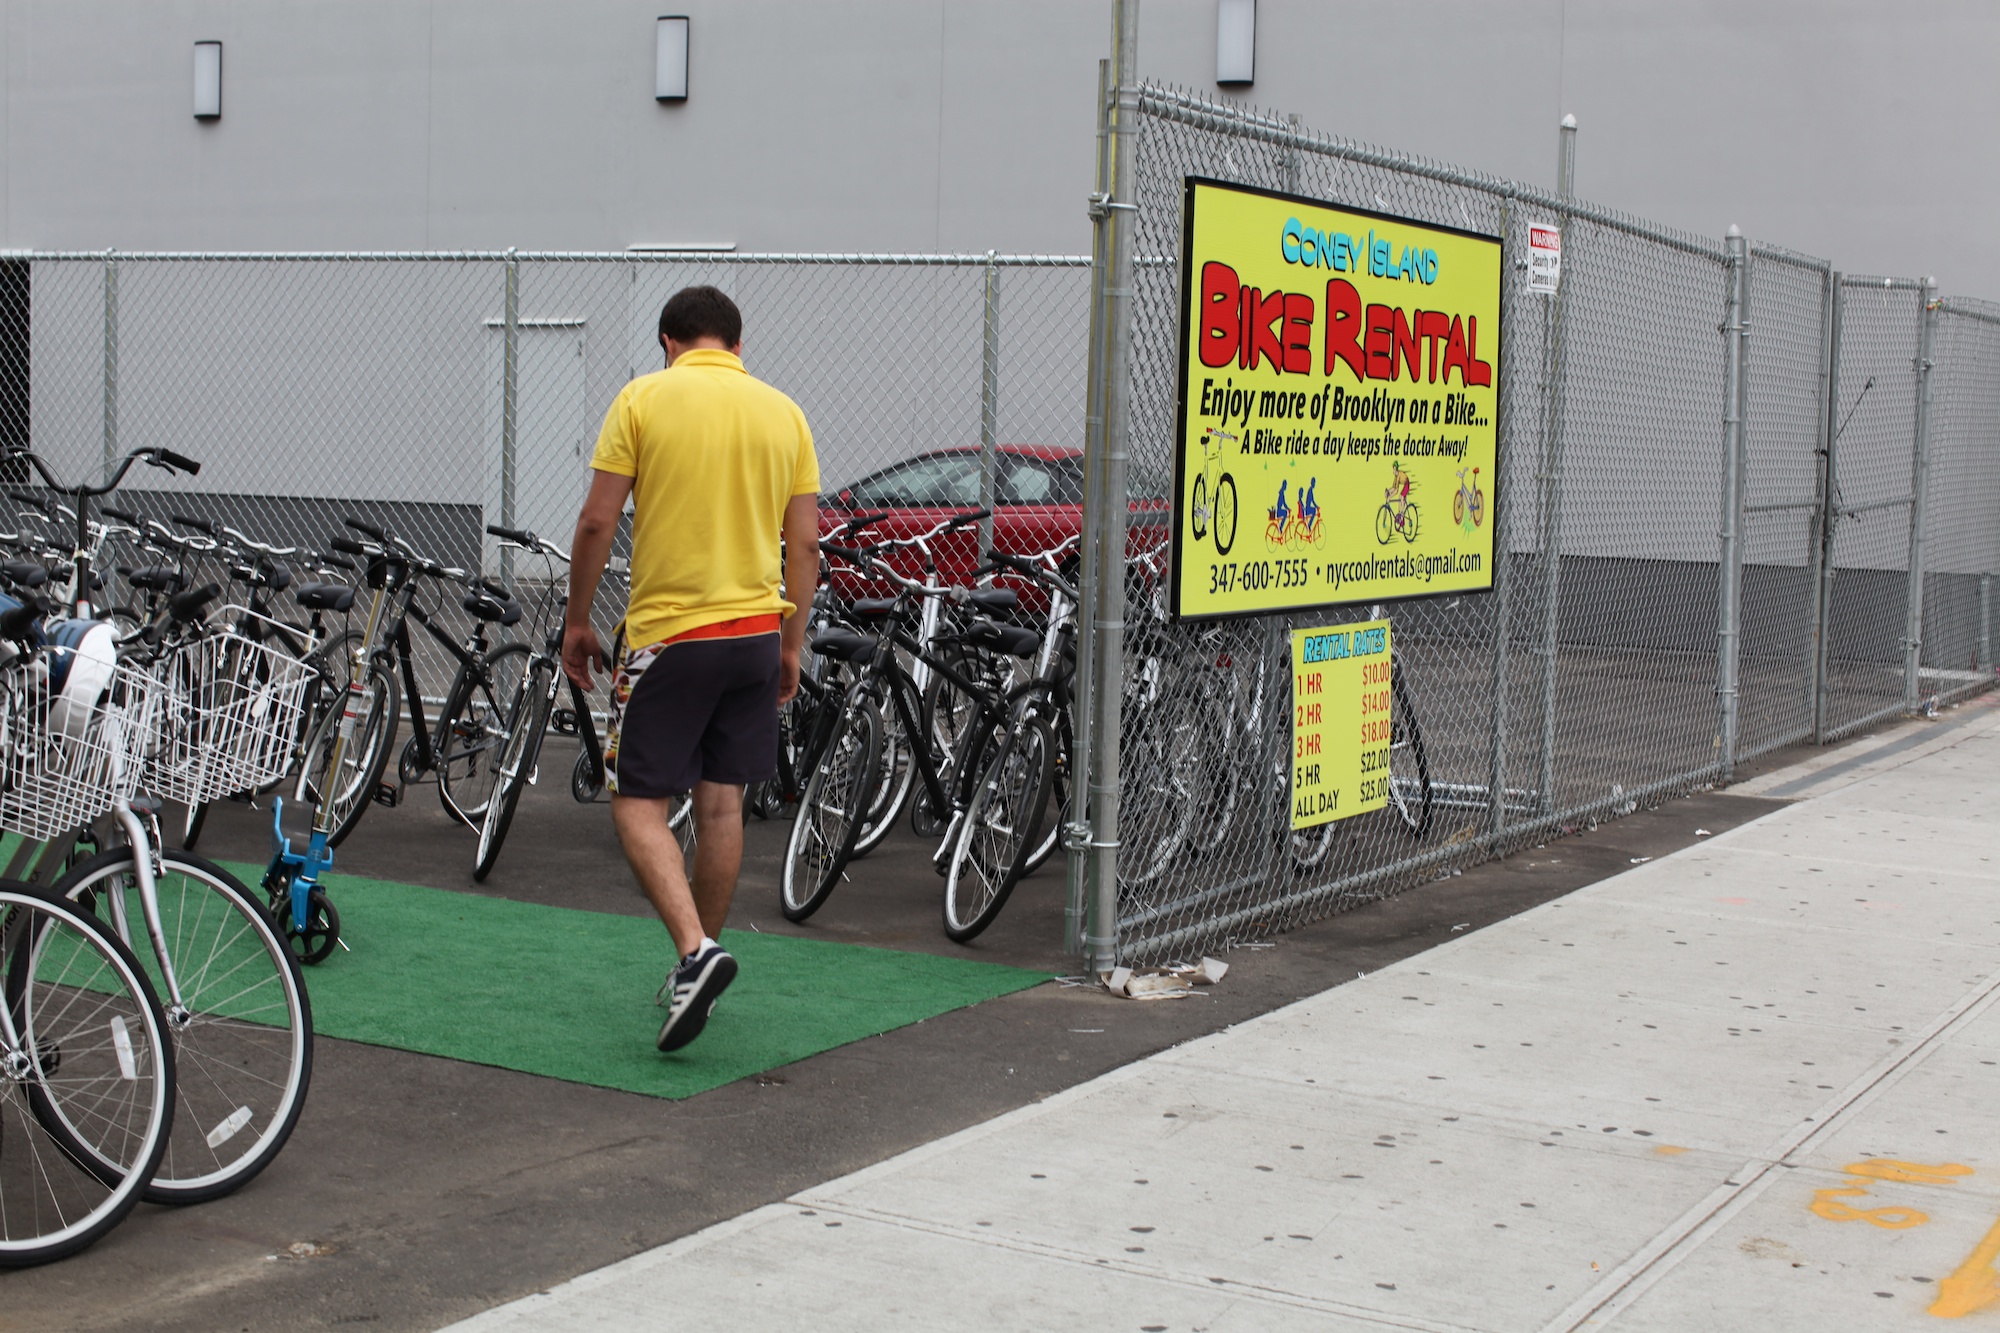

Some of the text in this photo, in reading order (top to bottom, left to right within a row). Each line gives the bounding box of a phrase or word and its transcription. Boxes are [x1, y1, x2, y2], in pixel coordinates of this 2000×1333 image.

[1532, 231, 1558, 250] WARNING
[1532, 252, 1549, 271] Security
[1532, 270, 1549, 285] Cameras
[1199, 260, 1491, 388] BIKE RENTAL
[1200, 377, 1488, 432] Enjoy more of Brooklyn on a Bike...
[1240, 428, 1468, 463] A Bike ride a day keeps the doctor Away!
[1209, 548, 1481, 594] 347-600-7555 nyccoolrentals@gmail.com
[1303, 627, 1386, 664] RENTAL RATES
[1297, 661, 1389, 696] 1 HR $10.00
[1297, 690, 1389, 727] 2 HR $14.00
[1296, 719, 1389, 758] 3 HR $18.00
[1296, 747, 1388, 789] 5 HR $22.00
[1295, 776, 1388, 819] ALL DAY $25.00
